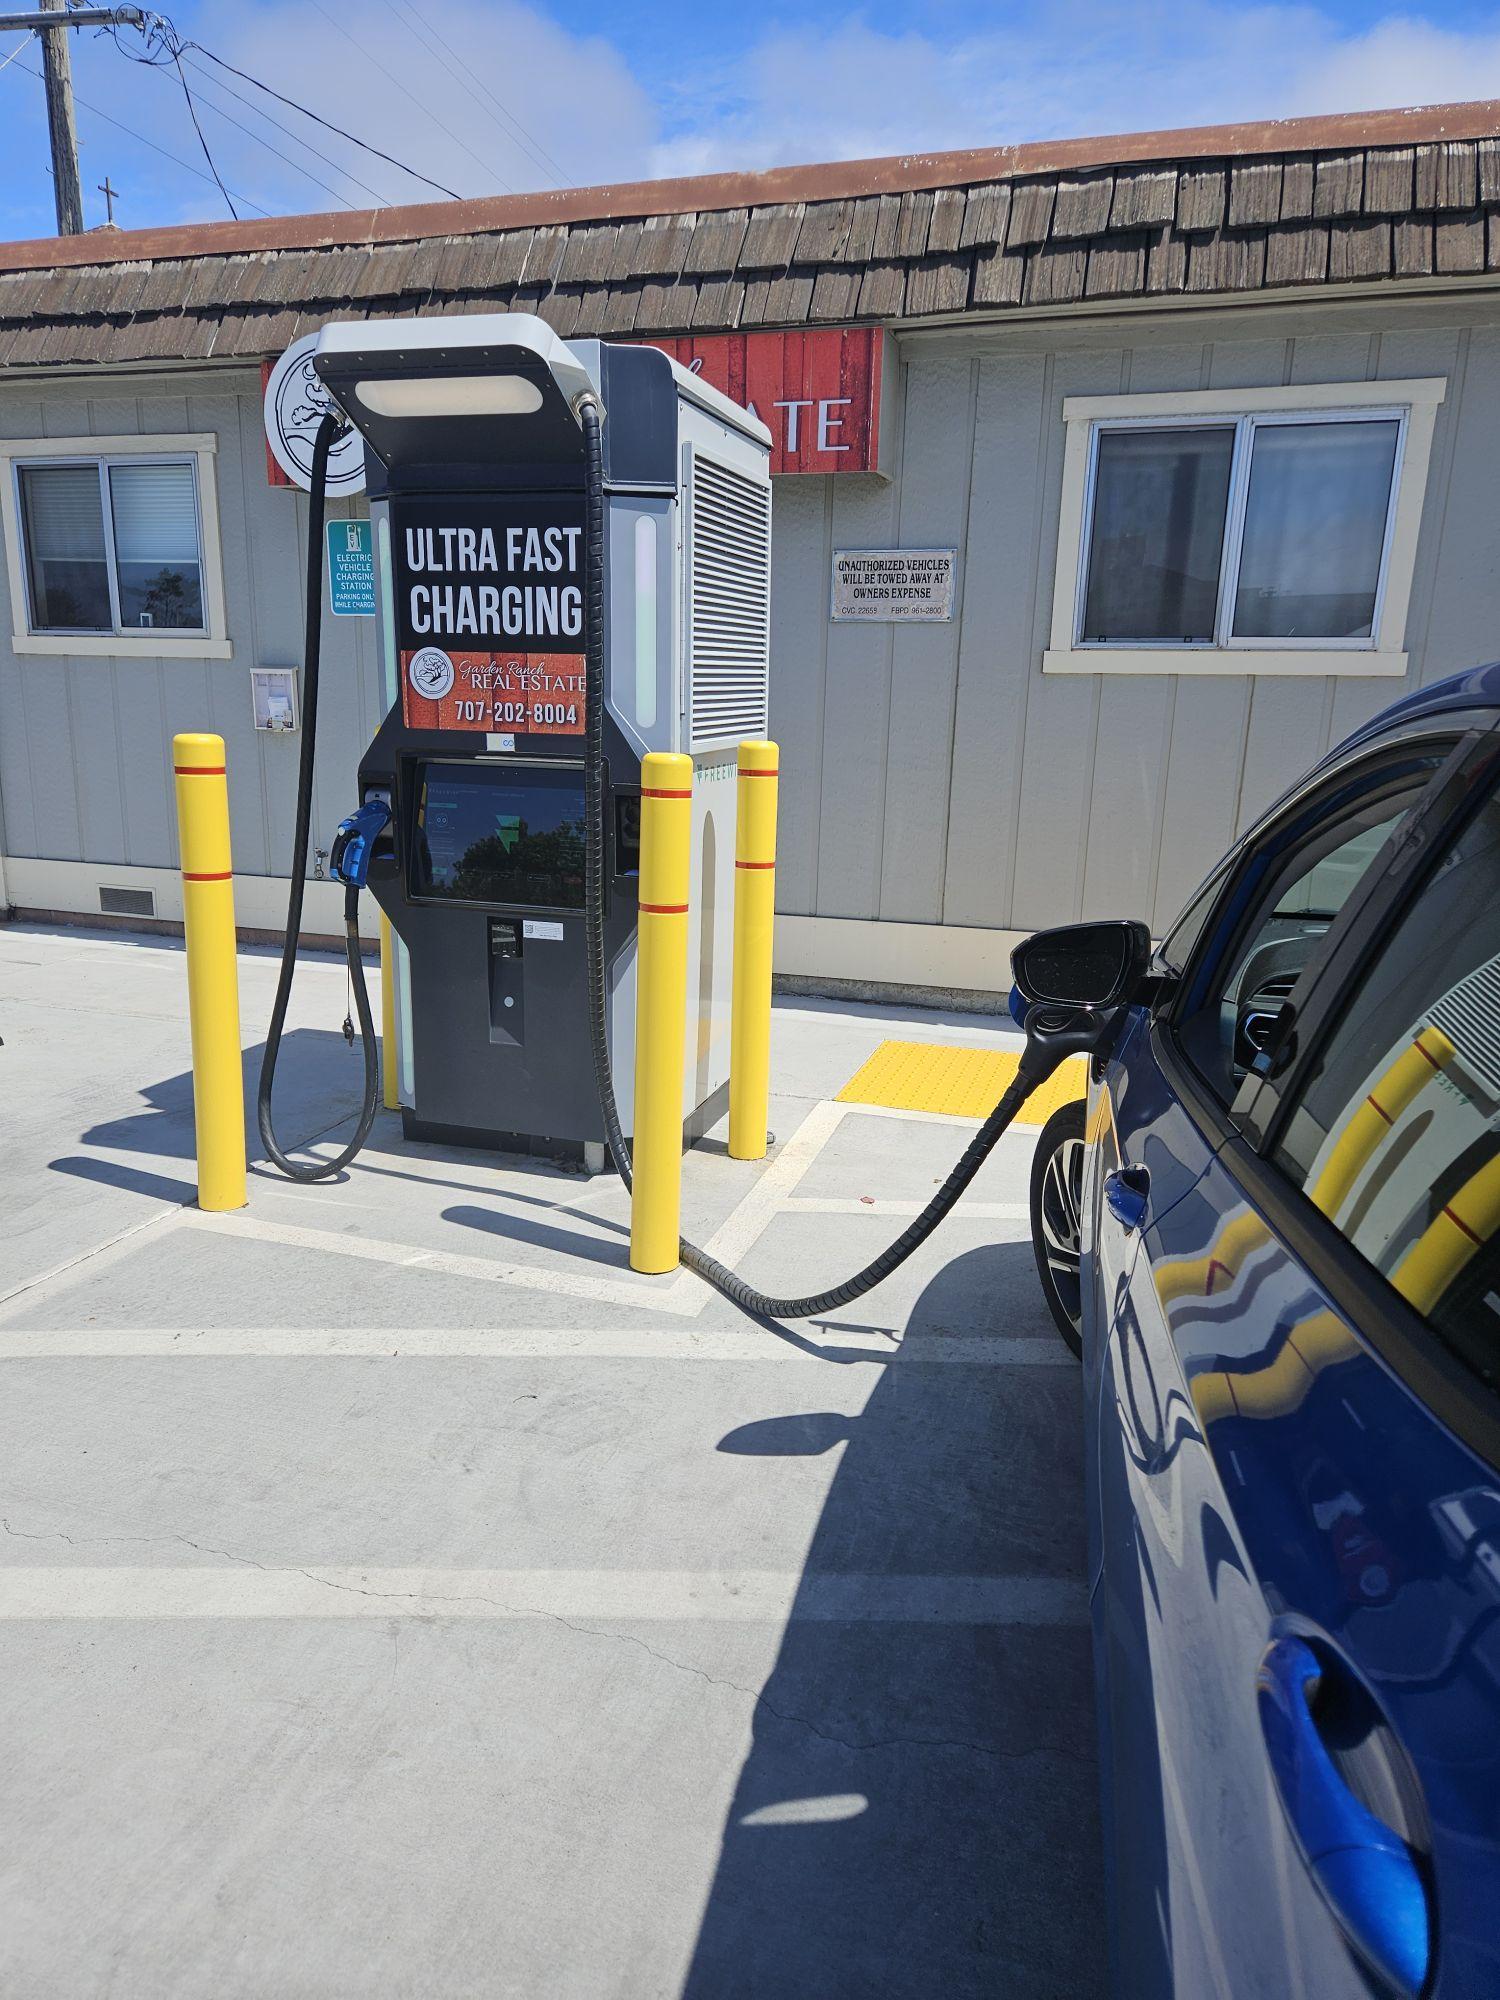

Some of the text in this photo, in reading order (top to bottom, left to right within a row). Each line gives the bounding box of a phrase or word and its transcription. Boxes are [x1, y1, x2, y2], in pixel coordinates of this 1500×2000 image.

[406, 527, 582, 572] ULTRA FAST
[336, 554, 372, 562] ELECTRIC
[339, 563, 371, 572] VEHICLE
[838, 559, 950, 572] UNAUTHORIZED VEHICLES
[842, 572, 945, 585] WILL BE TOWED AWAY AT
[340, 582, 372, 590] STATION
[853, 587, 931, 599] OWNERS EXPENSE
[410, 584, 582, 636] CHARGING
[458, 660, 546, 679] Garden Ranch
[471, 673, 586, 692] REAL ESTATE
[454, 700, 577, 724] 707-202-8004
